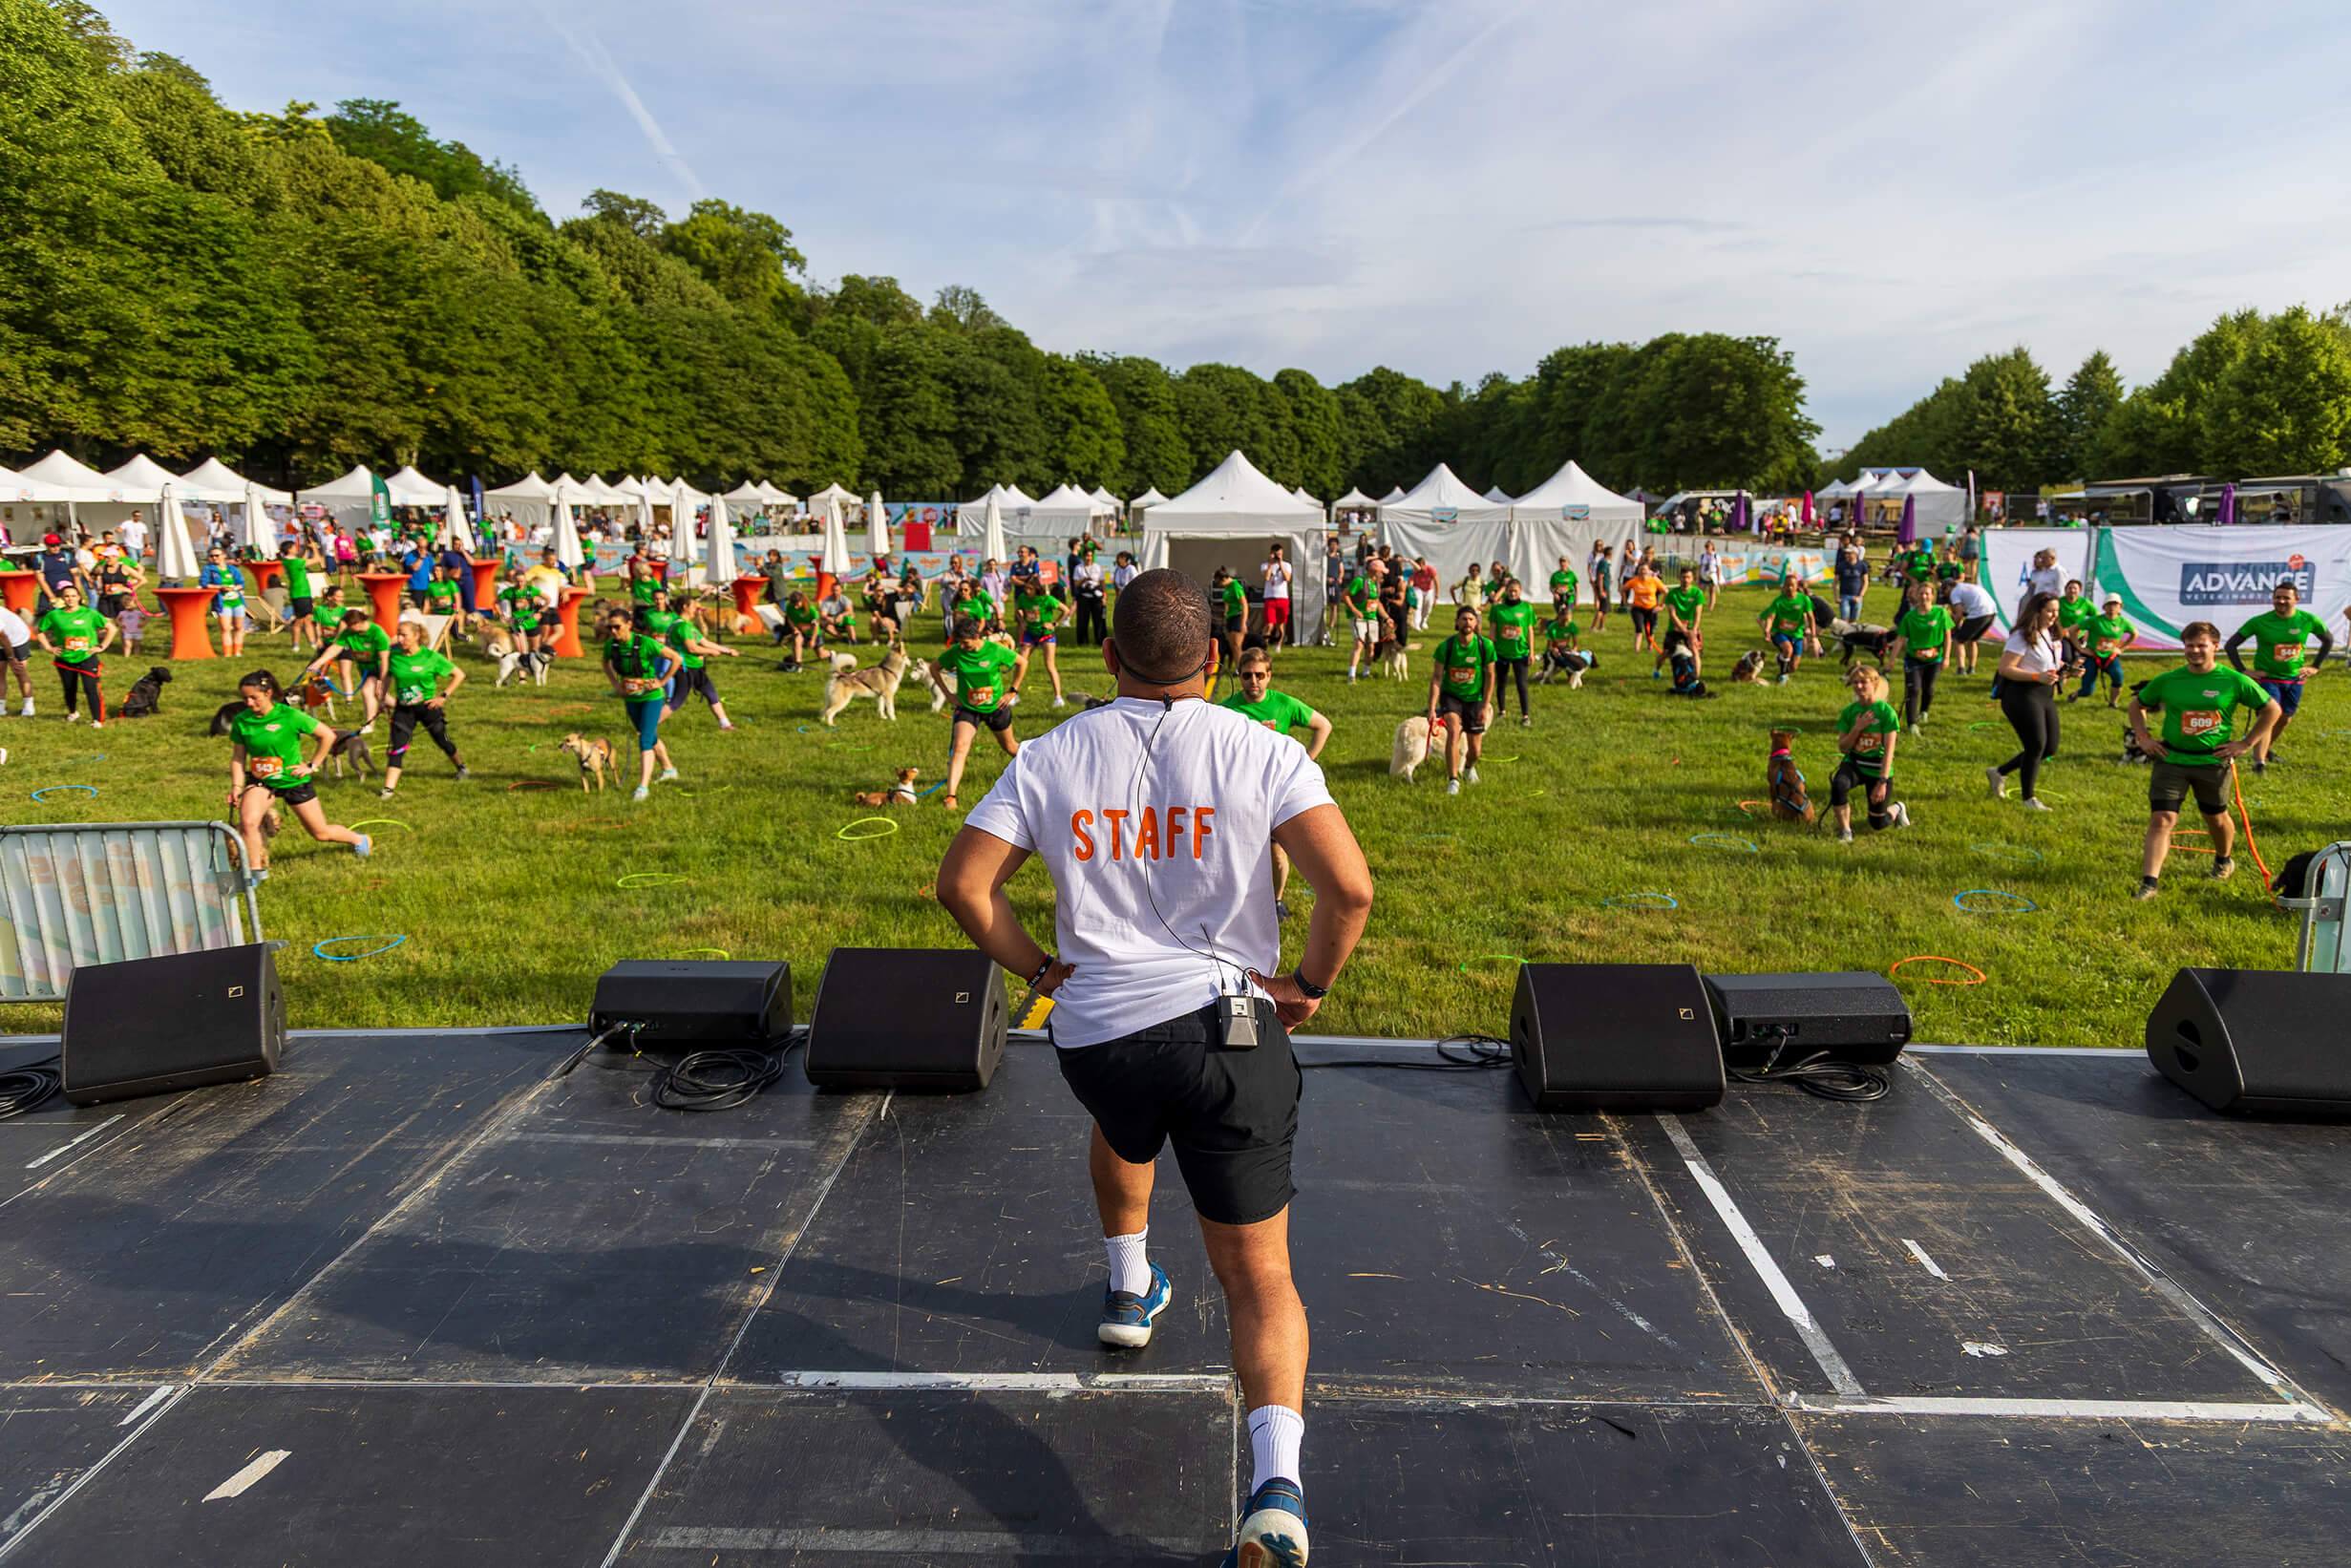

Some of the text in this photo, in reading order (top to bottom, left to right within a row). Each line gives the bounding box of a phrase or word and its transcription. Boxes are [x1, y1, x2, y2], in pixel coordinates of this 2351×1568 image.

[2186, 571, 2310, 592] ADVANCE
[2190, 717, 2213, 728] 609
[255, 763, 274, 773] 543
[1070, 806, 1216, 862] STAFF
